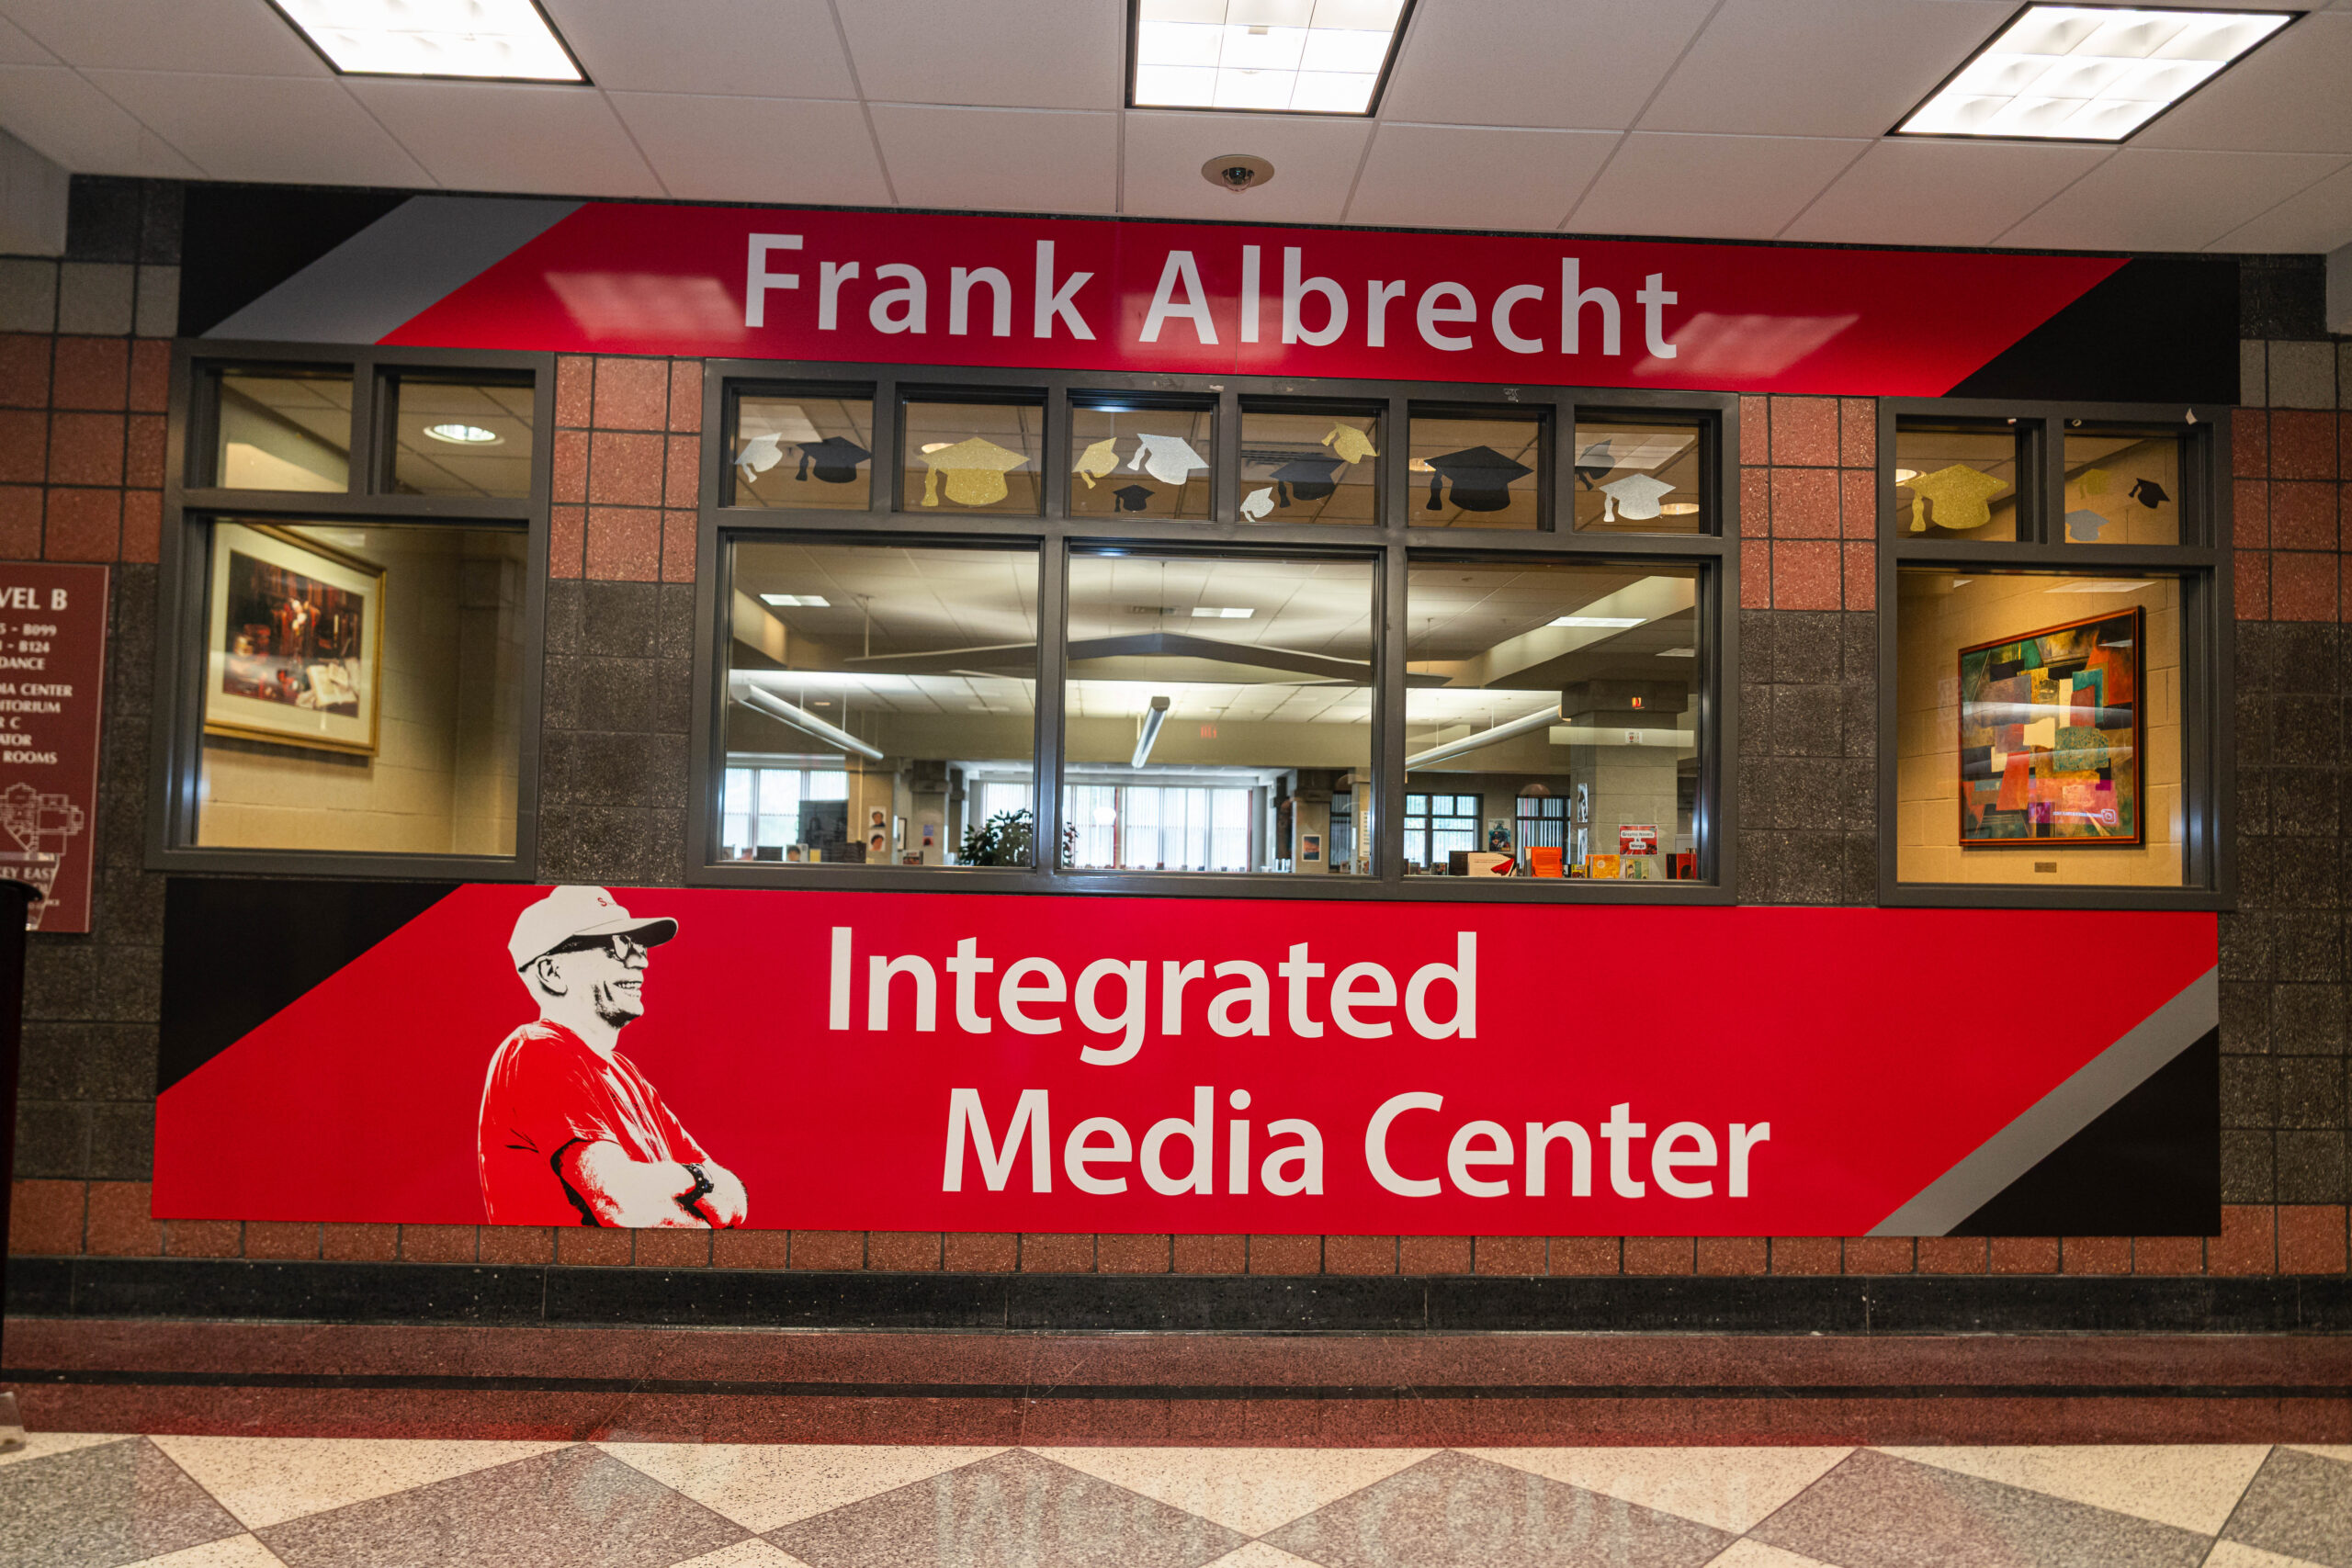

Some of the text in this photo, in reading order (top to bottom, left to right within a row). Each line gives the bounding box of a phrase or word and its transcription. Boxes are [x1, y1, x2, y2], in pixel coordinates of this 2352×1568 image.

[746, 233, 1678, 359] Frank Albrecht
[51, 588, 68, 611] B
[20, 682, 73, 697] CENTER
[10, 716, 21, 730] C
[3, 750, 58, 765] ROOMS
[0, 866, 19, 879] EY
[830, 926, 1477, 1066] Integrated
[943, 1086, 1770, 1199] Media Center
